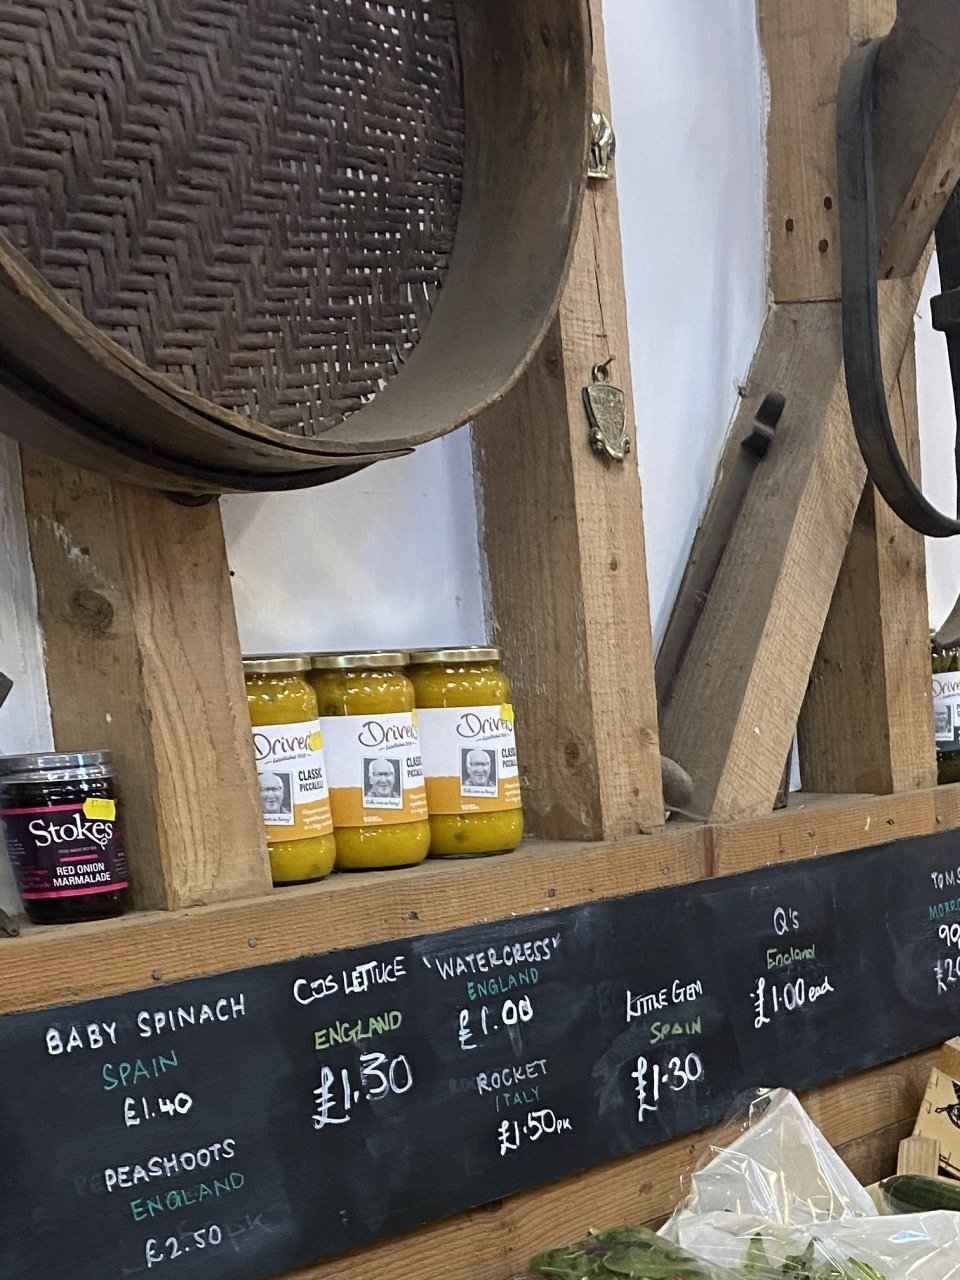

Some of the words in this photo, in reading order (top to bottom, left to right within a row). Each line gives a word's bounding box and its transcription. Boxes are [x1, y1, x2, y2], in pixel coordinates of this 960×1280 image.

[28, 813, 113, 850] Stokes
[53, 872, 111, 887] MARMALADE
[56, 866, 75, 876] RED
[77, 862, 105, 873] ONION
[767, 944, 815, 969] England
[293, 975, 339, 1004] COS
[343, 956, 407, 995] LETTUCE
[467, 966, 540, 1000] ENGLAND
[46, 1022, 118, 1055] BABY
[137, 993, 246, 1038] SPINACH
[314, 1011, 402, 1050] ENGLAND
[458, 996, 534, 1050] £1.00
[650, 1017, 702, 1044] SPAIN
[102, 1050, 178, 1091] SPAIN
[476, 1059, 548, 1095] ROCKET
[631, 1052, 703, 1123] £1.30
[312, 1052, 413, 1129] £1.30
[495, 1086, 541, 1112] ITALY
[124, 1093, 193, 1128] £1.40
[105, 1138, 237, 1192] PEASHOOTS
[130, 1172, 245, 1222] ENGLAND
[145, 1224, 222, 1268] £2.50
